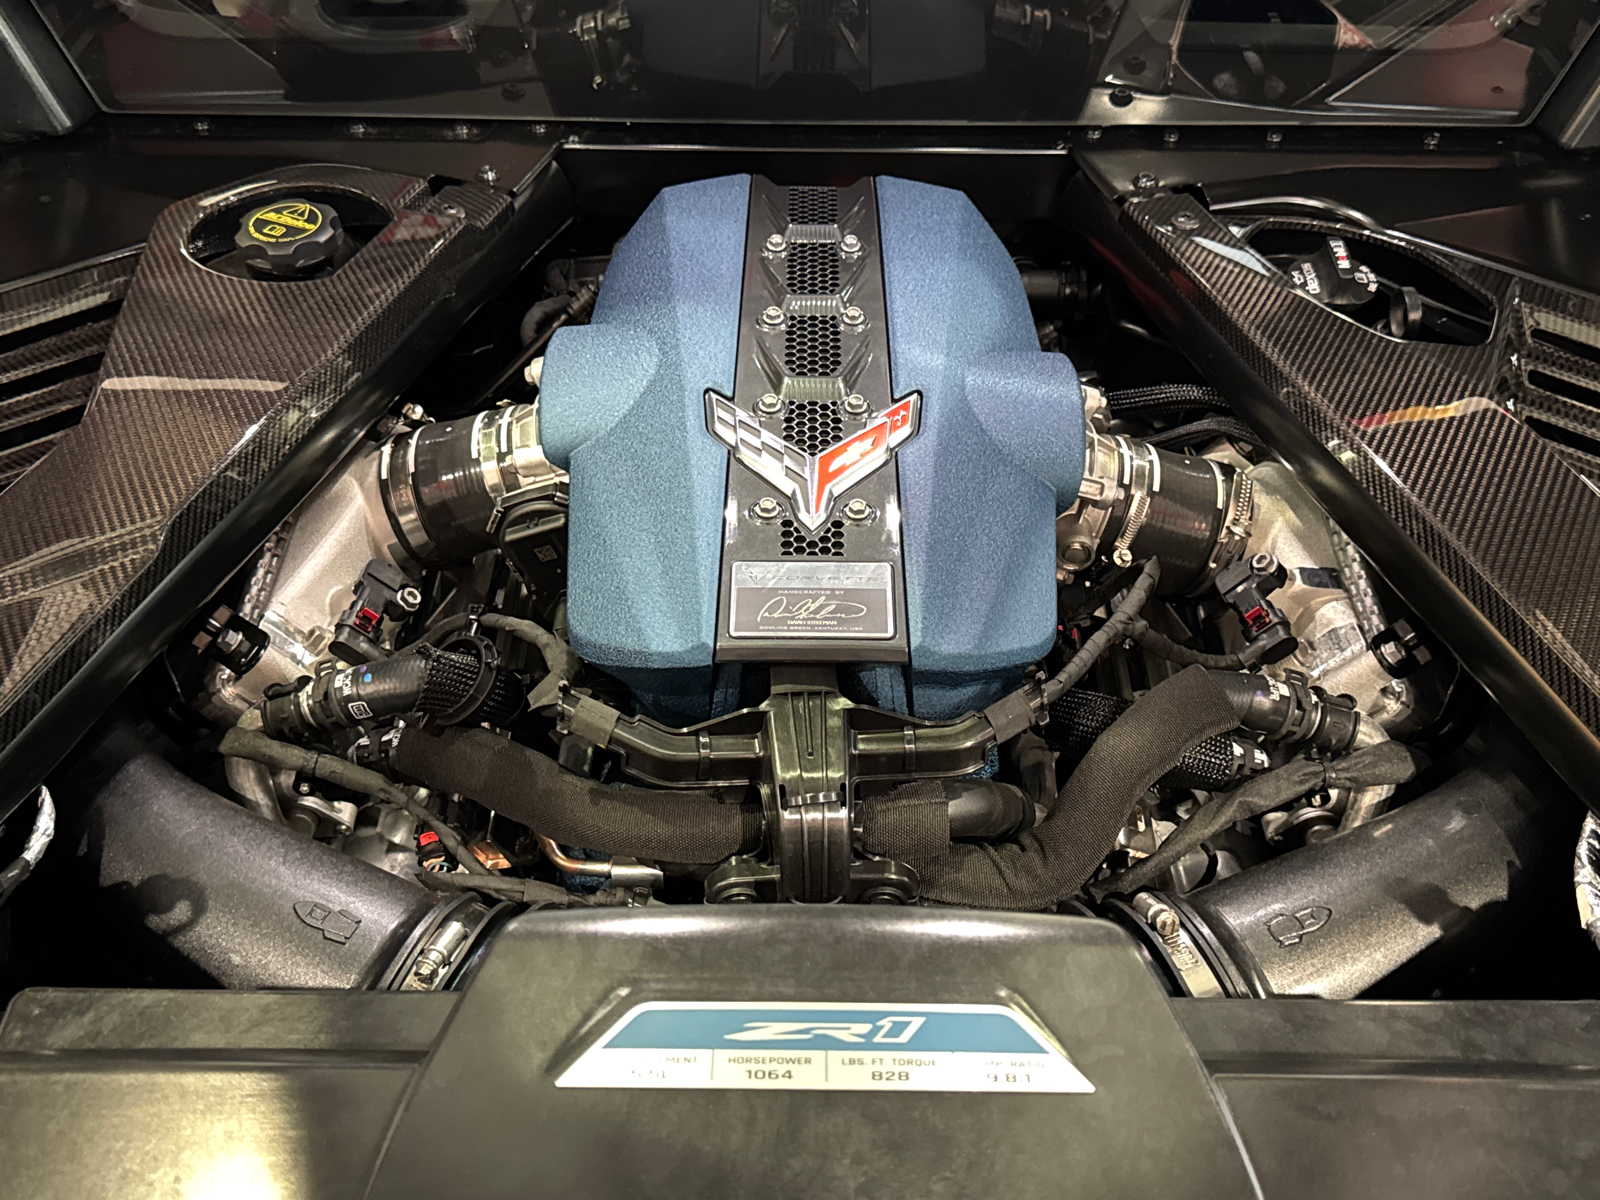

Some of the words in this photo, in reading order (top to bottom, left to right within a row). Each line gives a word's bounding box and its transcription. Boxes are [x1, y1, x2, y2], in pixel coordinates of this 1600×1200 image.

[261, 211, 317, 230] ACDelco
[1301, 263, 1320, 294] dexos
[723, 1016, 927, 1043] ZR1
[728, 1056, 812, 1065] HORSEPOWER
[841, 1058, 868, 1066] LBS.
[871, 1058, 887, 1066] FT.
[892, 1058, 936, 1067] TORQUE
[745, 1069, 793, 1080] 1064
[871, 1071, 910, 1081] 828
